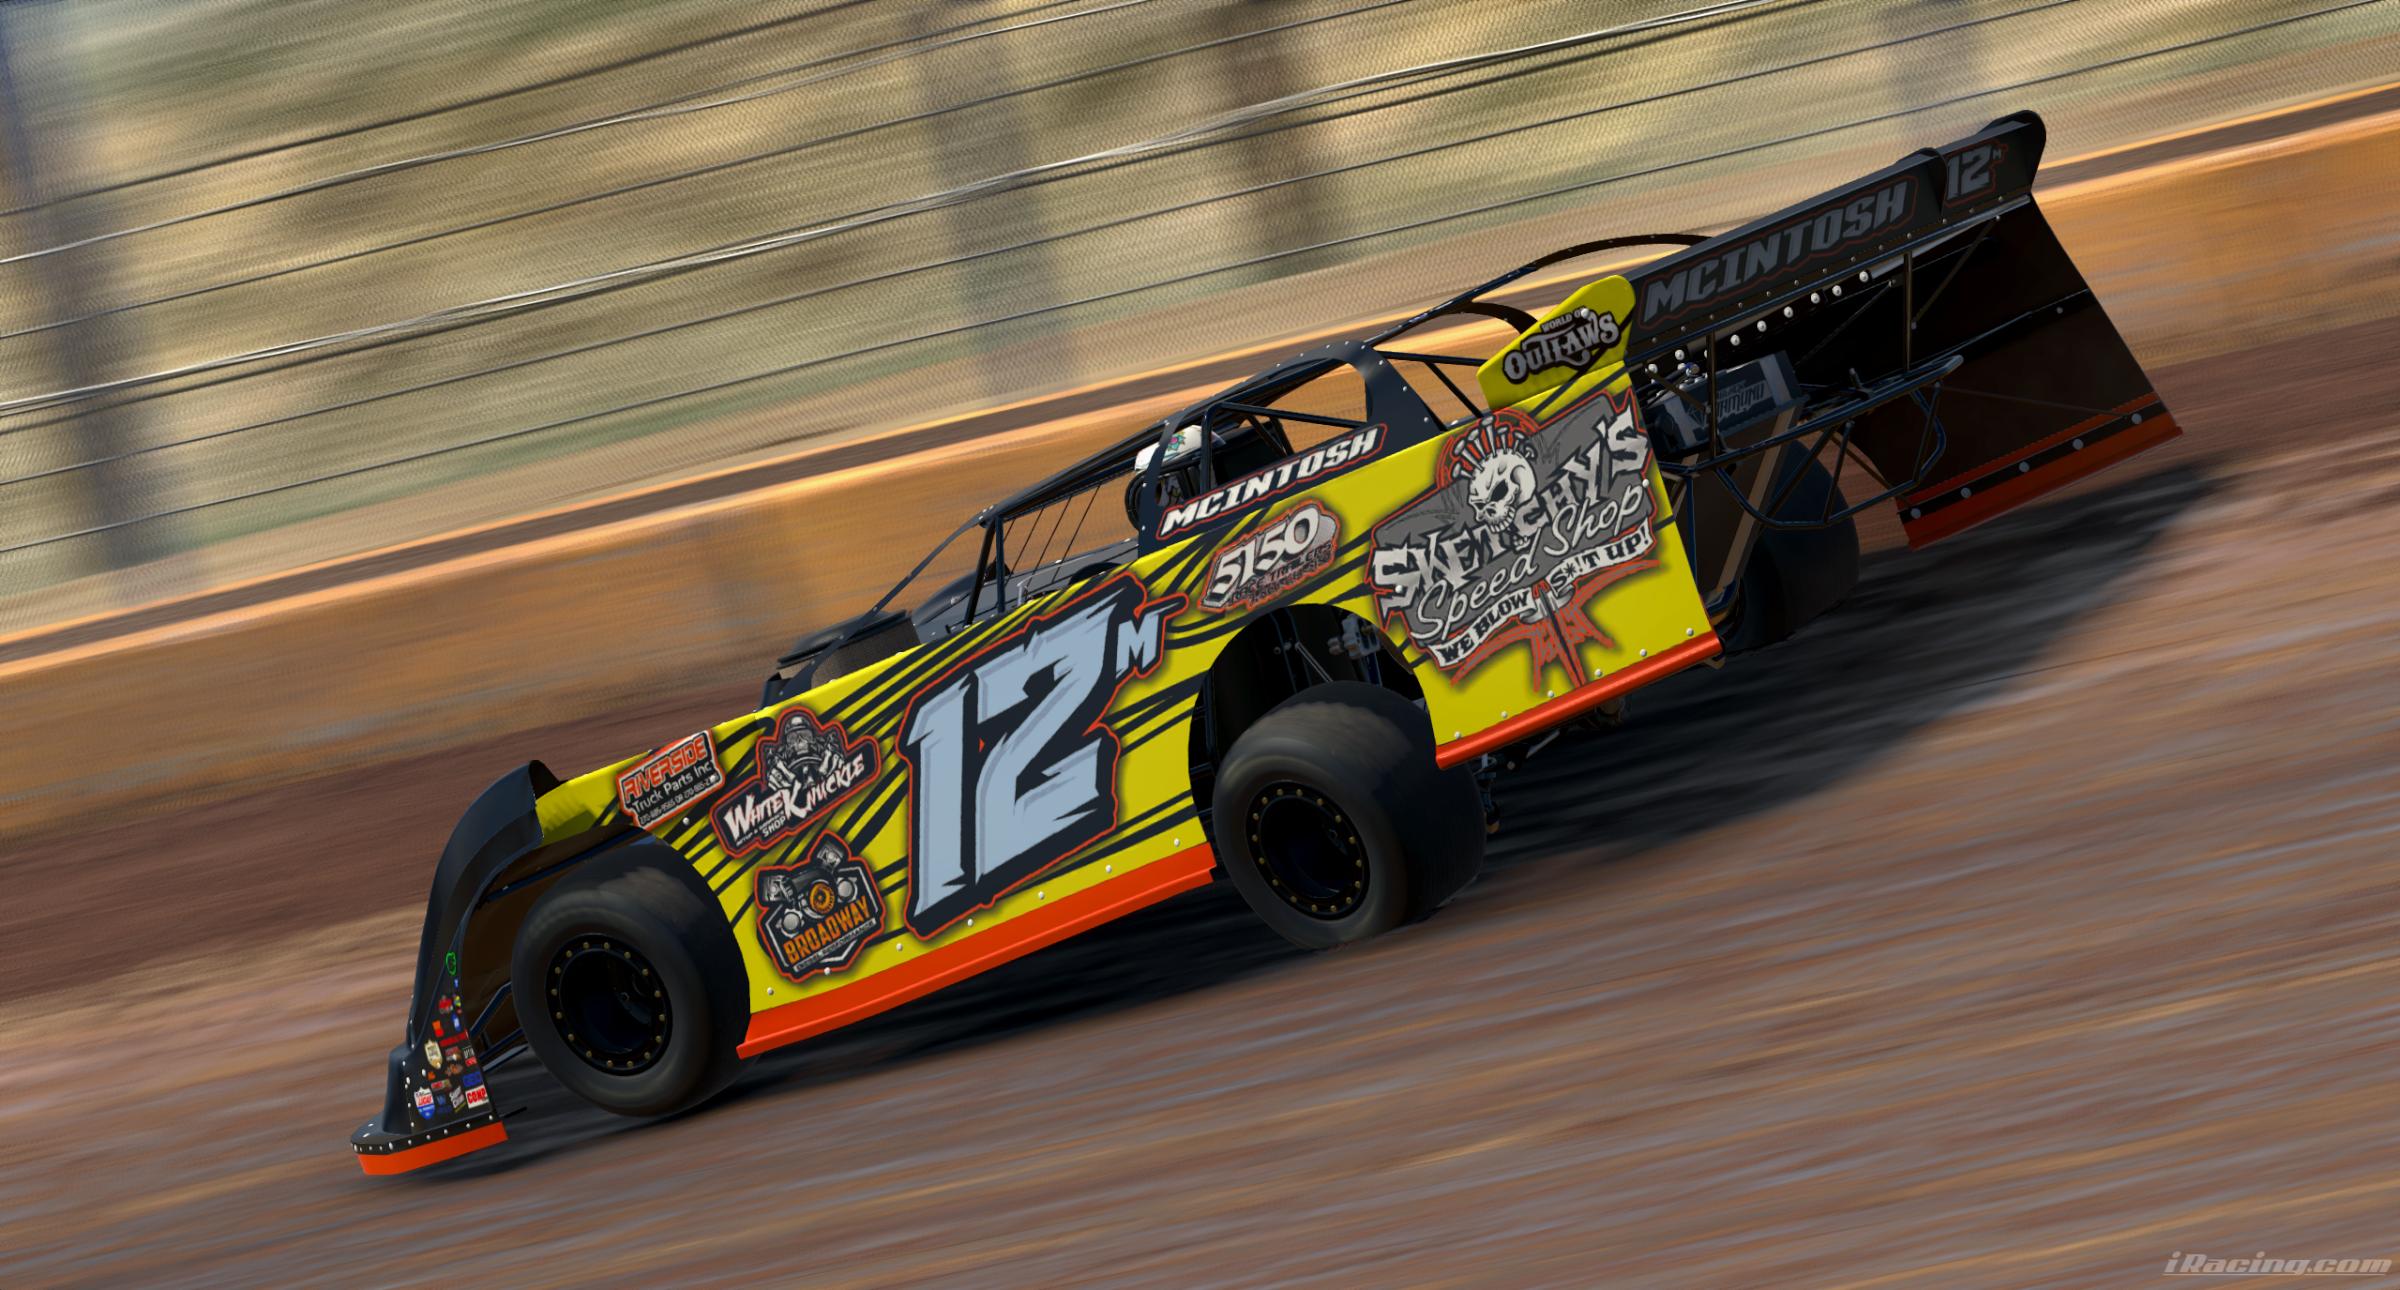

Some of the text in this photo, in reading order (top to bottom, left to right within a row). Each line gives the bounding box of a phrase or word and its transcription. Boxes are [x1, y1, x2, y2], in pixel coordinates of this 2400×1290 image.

[1642, 180, 1909, 323] MCINTOSH
[1504, 311, 1619, 380] OUTLAWS
[1541, 314, 1573, 332] WORLD
[1160, 427, 1379, 536] MCINTOSH
[1211, 507, 1320, 594] 5150
[1411, 527, 1541, 640] Speed
[1544, 485, 1643, 557] Shop
[1440, 636, 1473, 664] WE
[1474, 589, 1531, 635] BLOW
[623, 735, 707, 803] RIVERSIDE
[632, 761, 712, 812] Truck Parts Inc
[762, 815, 786, 837] SHOP
[783, 896, 870, 964] BROADWAY
